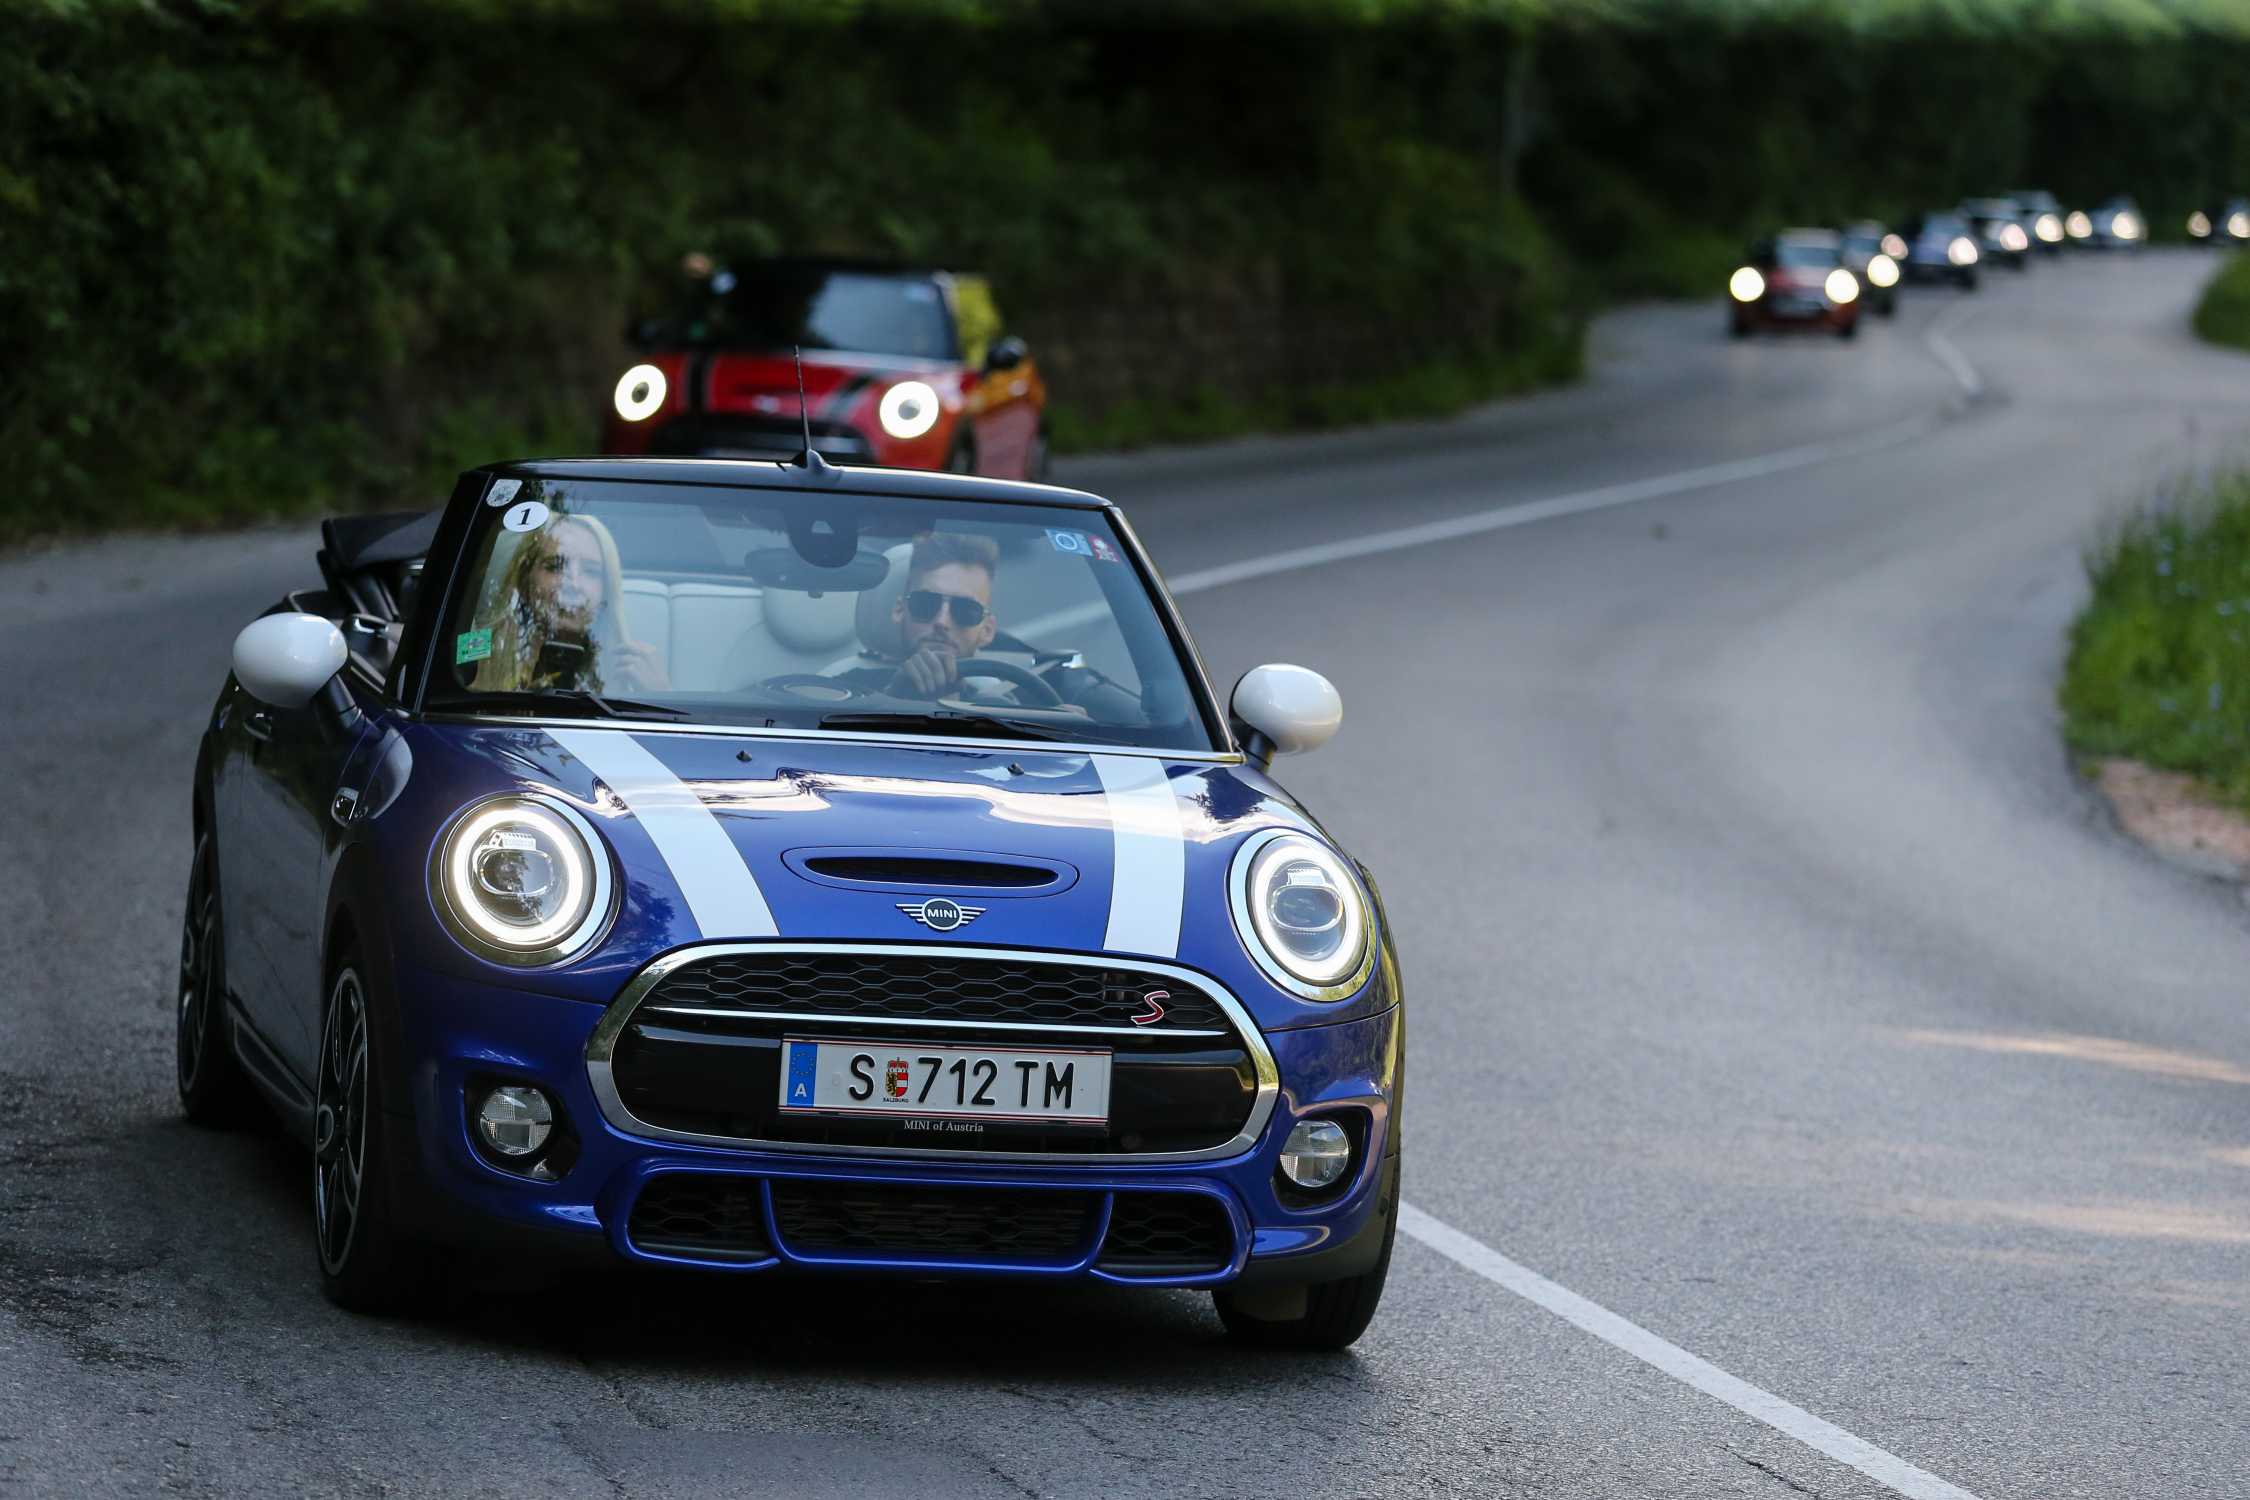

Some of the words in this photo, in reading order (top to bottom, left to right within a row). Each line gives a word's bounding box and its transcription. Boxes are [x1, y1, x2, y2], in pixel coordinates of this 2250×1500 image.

[517, 508, 531, 525] 1
[927, 908, 957, 919] MINI
[1131, 990, 1171, 1025] S
[849, 1053, 876, 1101] S
[917, 1056, 999, 1106] 712
[1014, 1060, 1075, 1109] TM
[794, 1083, 808, 1098] A
[904, 1119, 930, 1131] MINI
[933, 1120, 944, 1131] of
[946, 1121, 984, 1133] Austria
